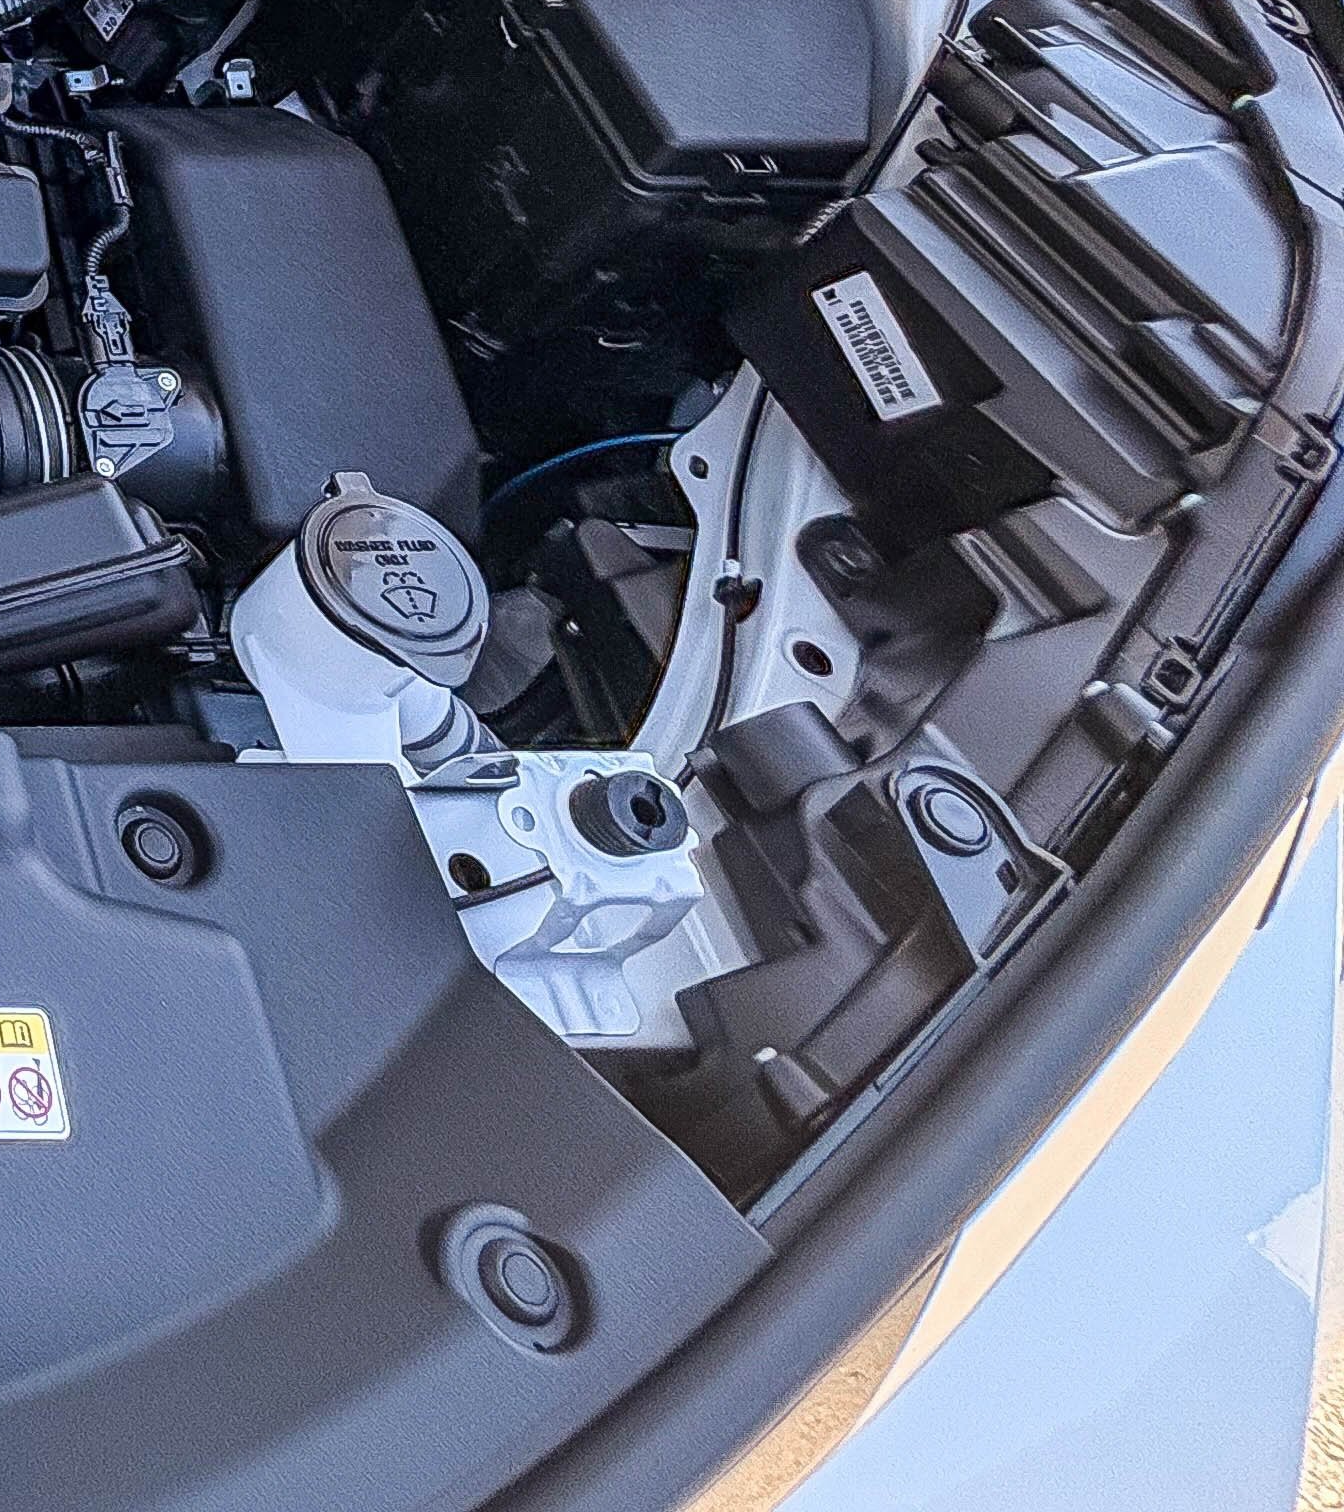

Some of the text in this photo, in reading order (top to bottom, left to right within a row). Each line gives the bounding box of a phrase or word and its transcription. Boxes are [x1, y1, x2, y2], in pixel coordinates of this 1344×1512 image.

[333, 539, 438, 553] WASHER FLUID
[374, 552, 410, 567] ONLY
